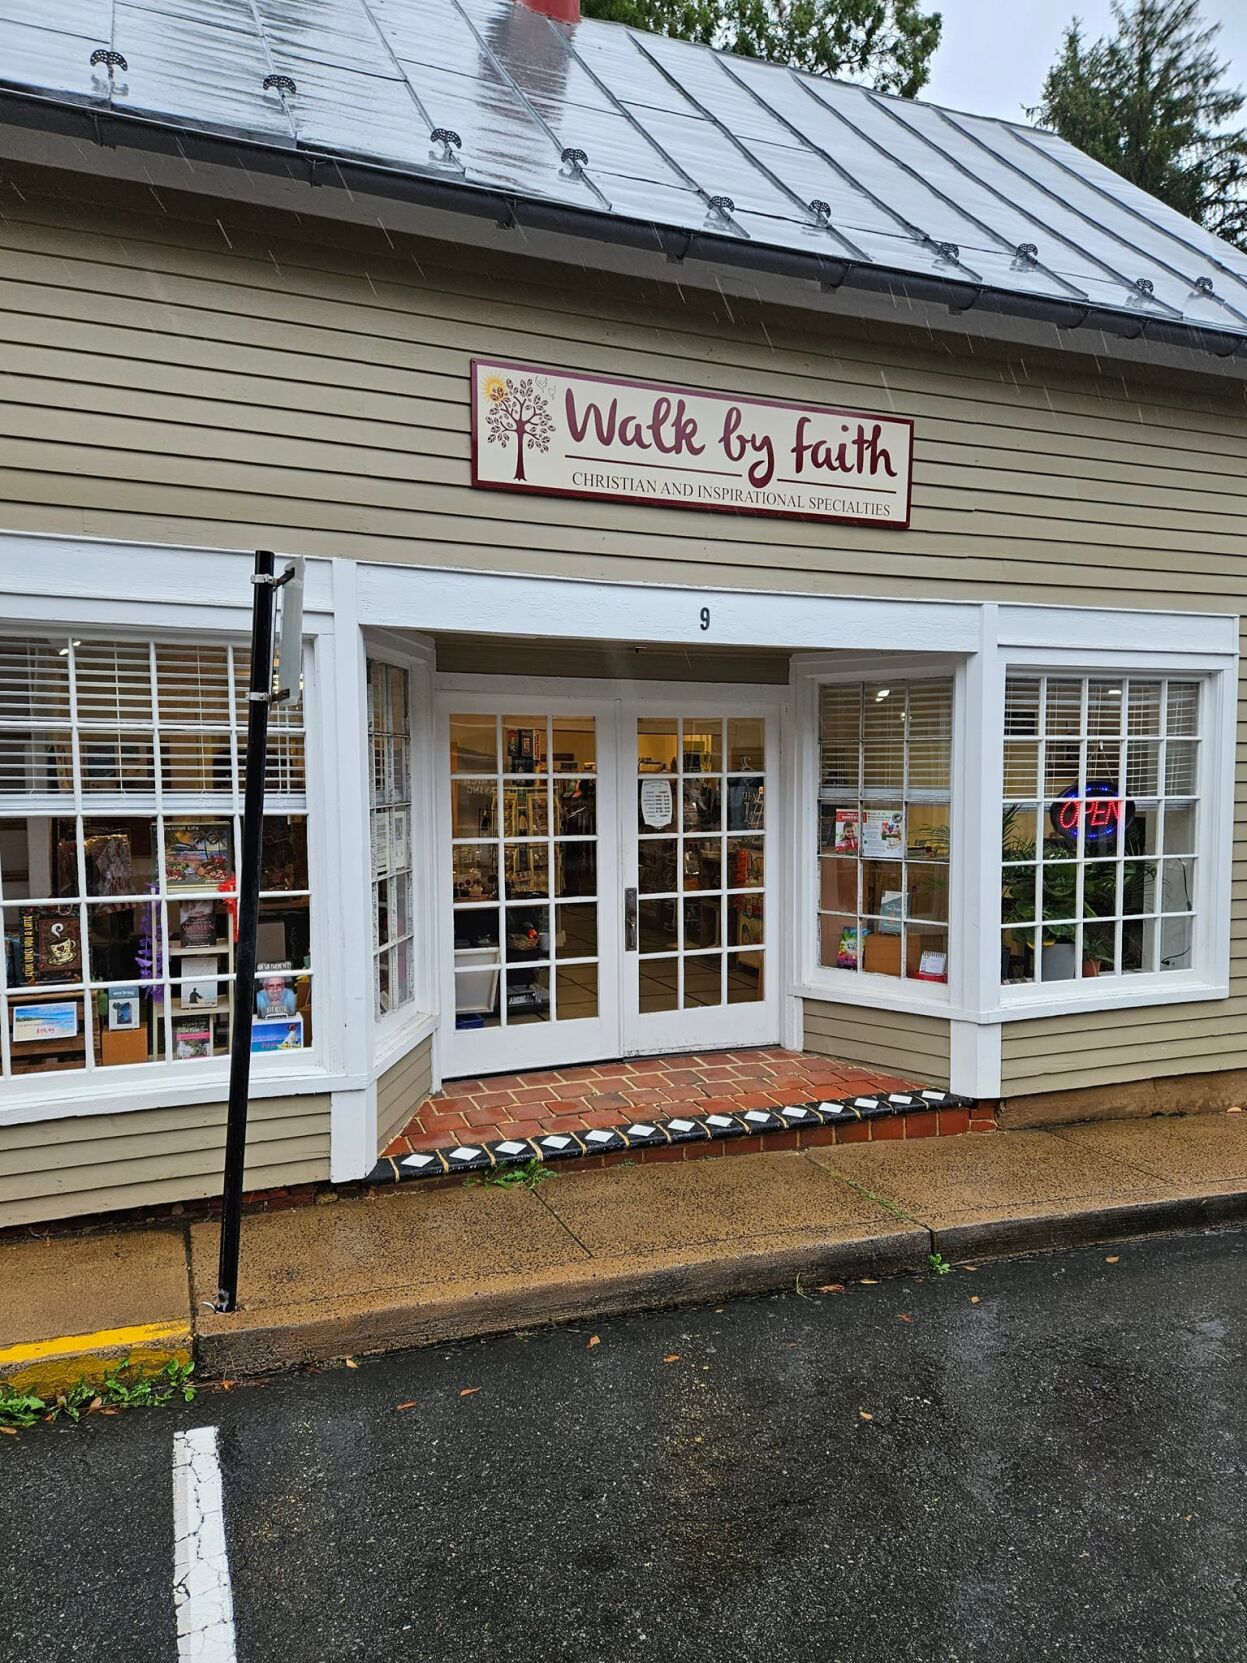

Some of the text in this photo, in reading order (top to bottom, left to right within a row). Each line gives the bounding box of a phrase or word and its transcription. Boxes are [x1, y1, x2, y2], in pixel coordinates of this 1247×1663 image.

[565, 387, 898, 489] Walk by faith
[572, 471, 892, 517] CHRISTIAN AND INSPIRATIONAL SPECIALTIES
[700, 607, 710, 631] 9
[1058, 799, 1123, 829] OPEN
[24, 936, 34, 947] YOU
